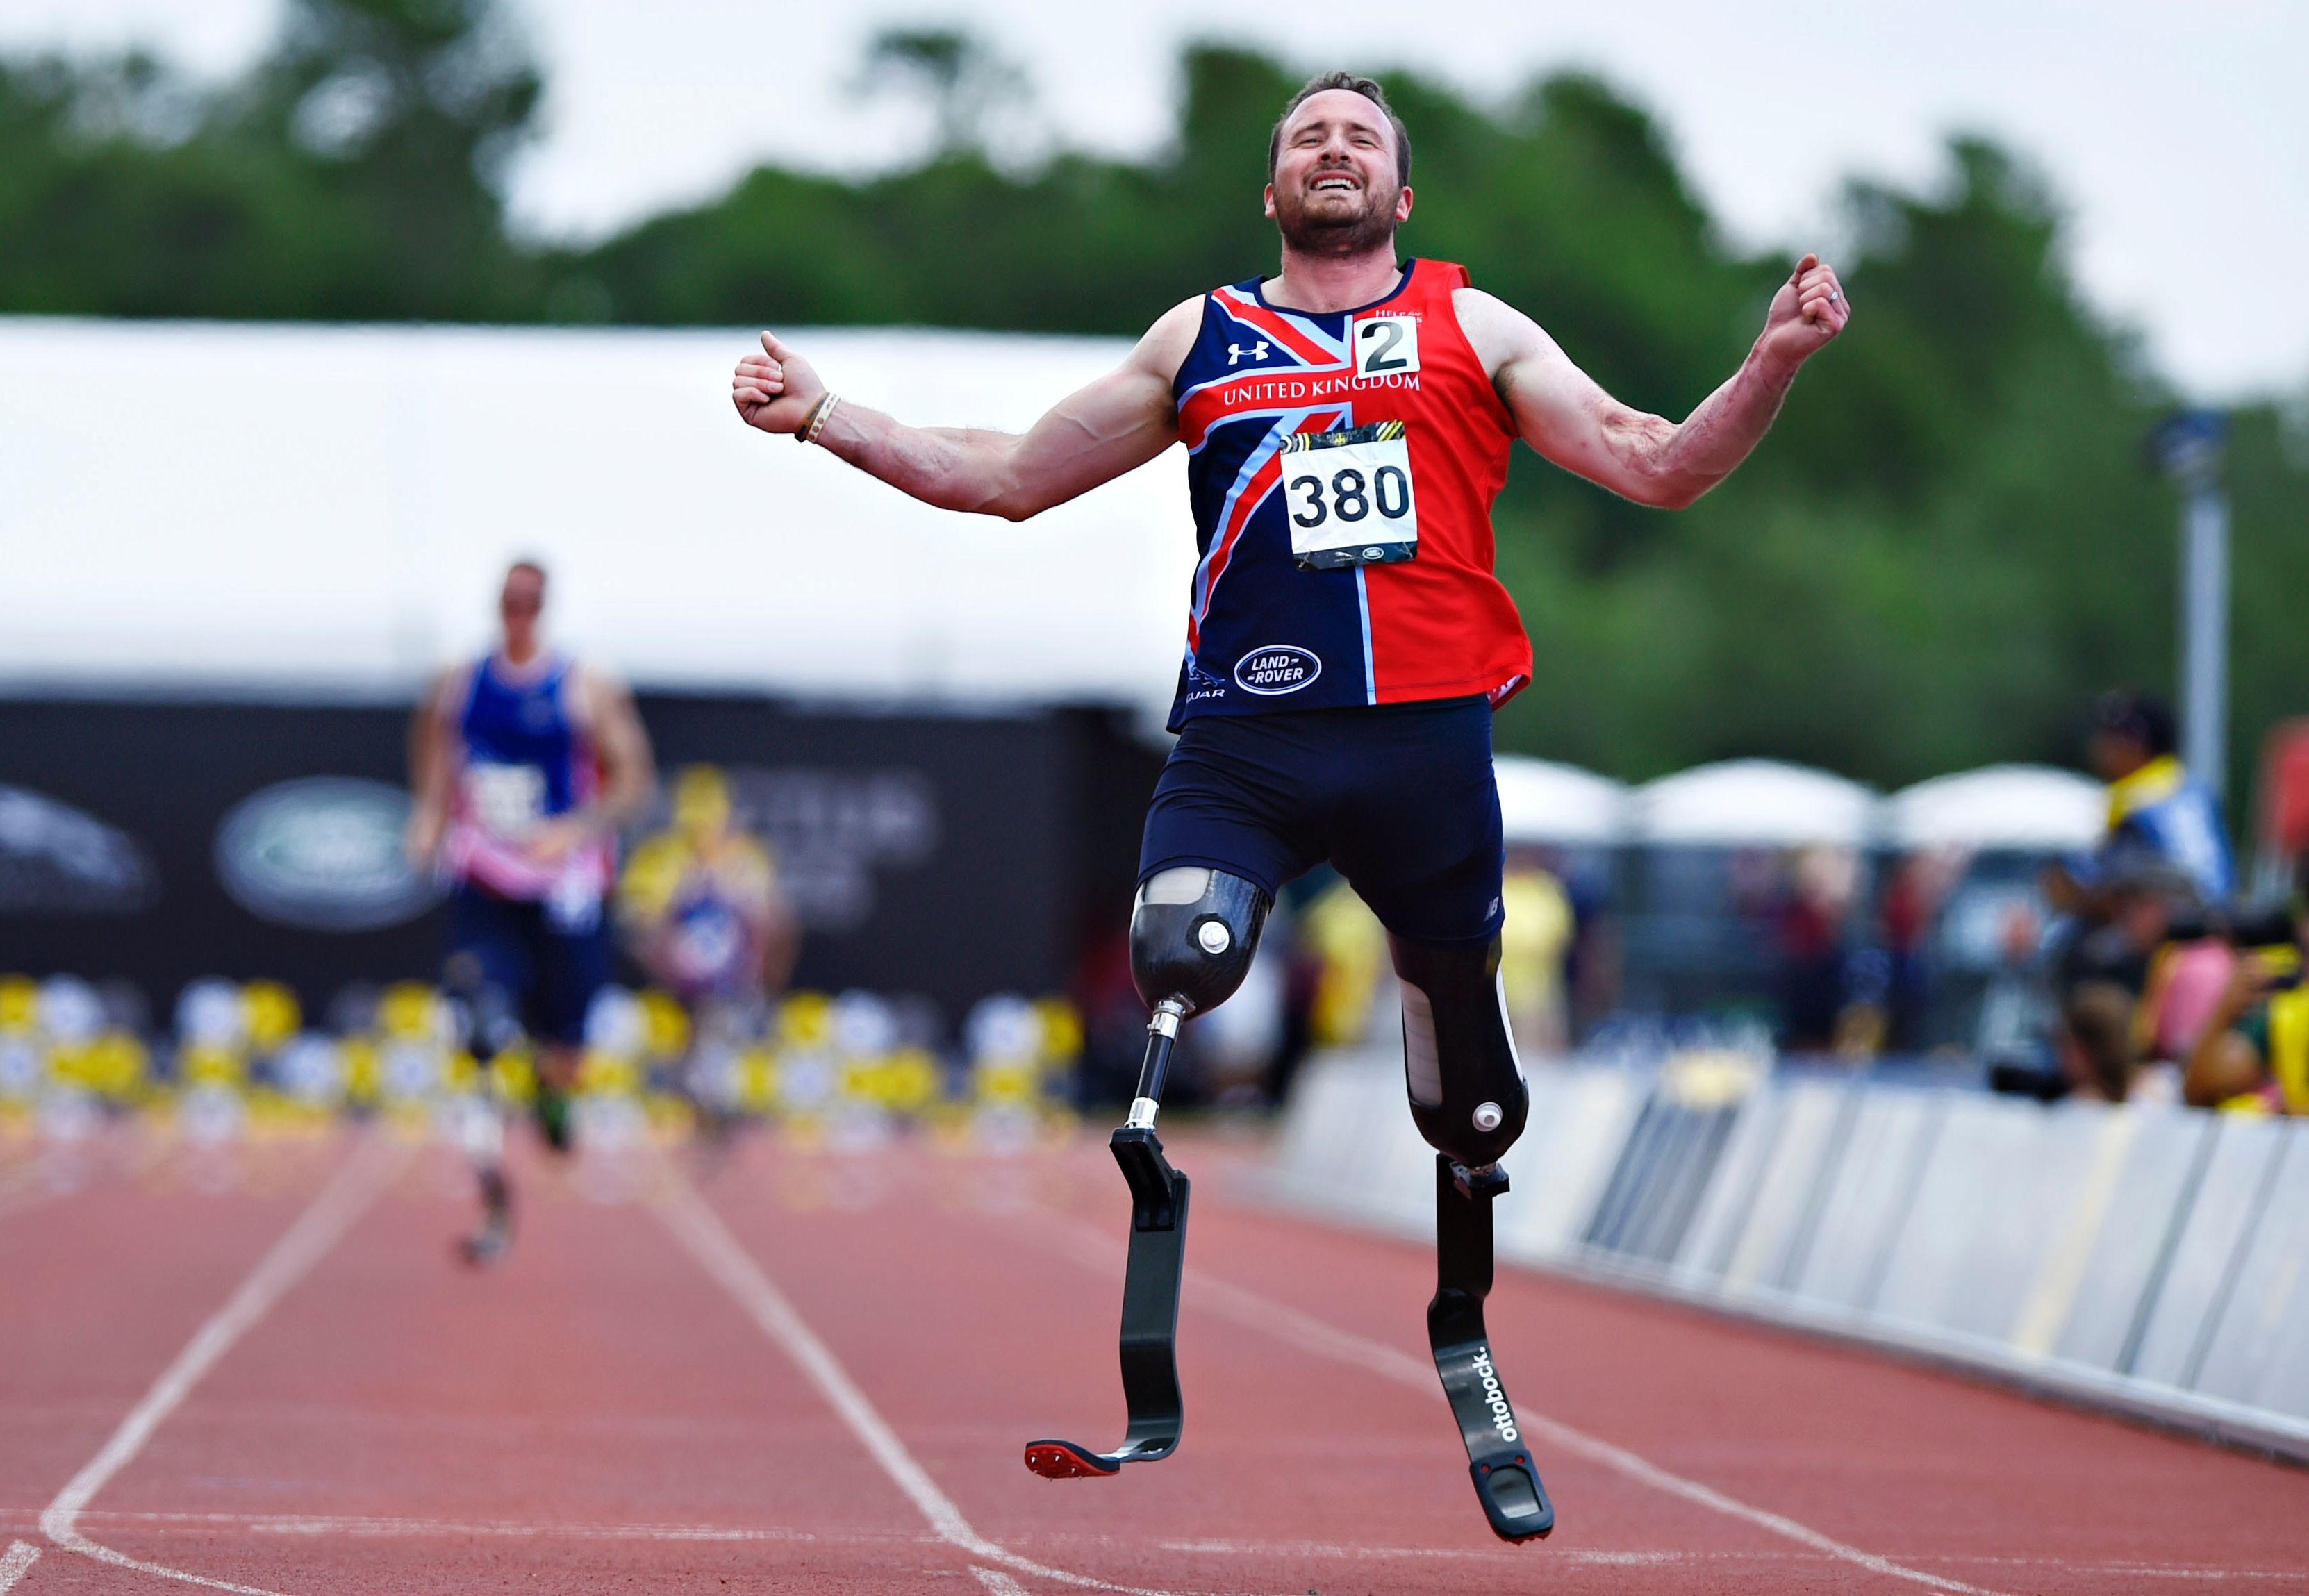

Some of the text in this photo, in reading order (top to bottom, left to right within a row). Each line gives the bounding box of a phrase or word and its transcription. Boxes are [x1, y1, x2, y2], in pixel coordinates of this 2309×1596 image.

[1362, 322, 1407, 372] 2
[1224, 374, 1421, 406] UNITED KINGDOM
[1290, 465, 1410, 528] 380
[1186, 688, 1225, 704] GUAR
